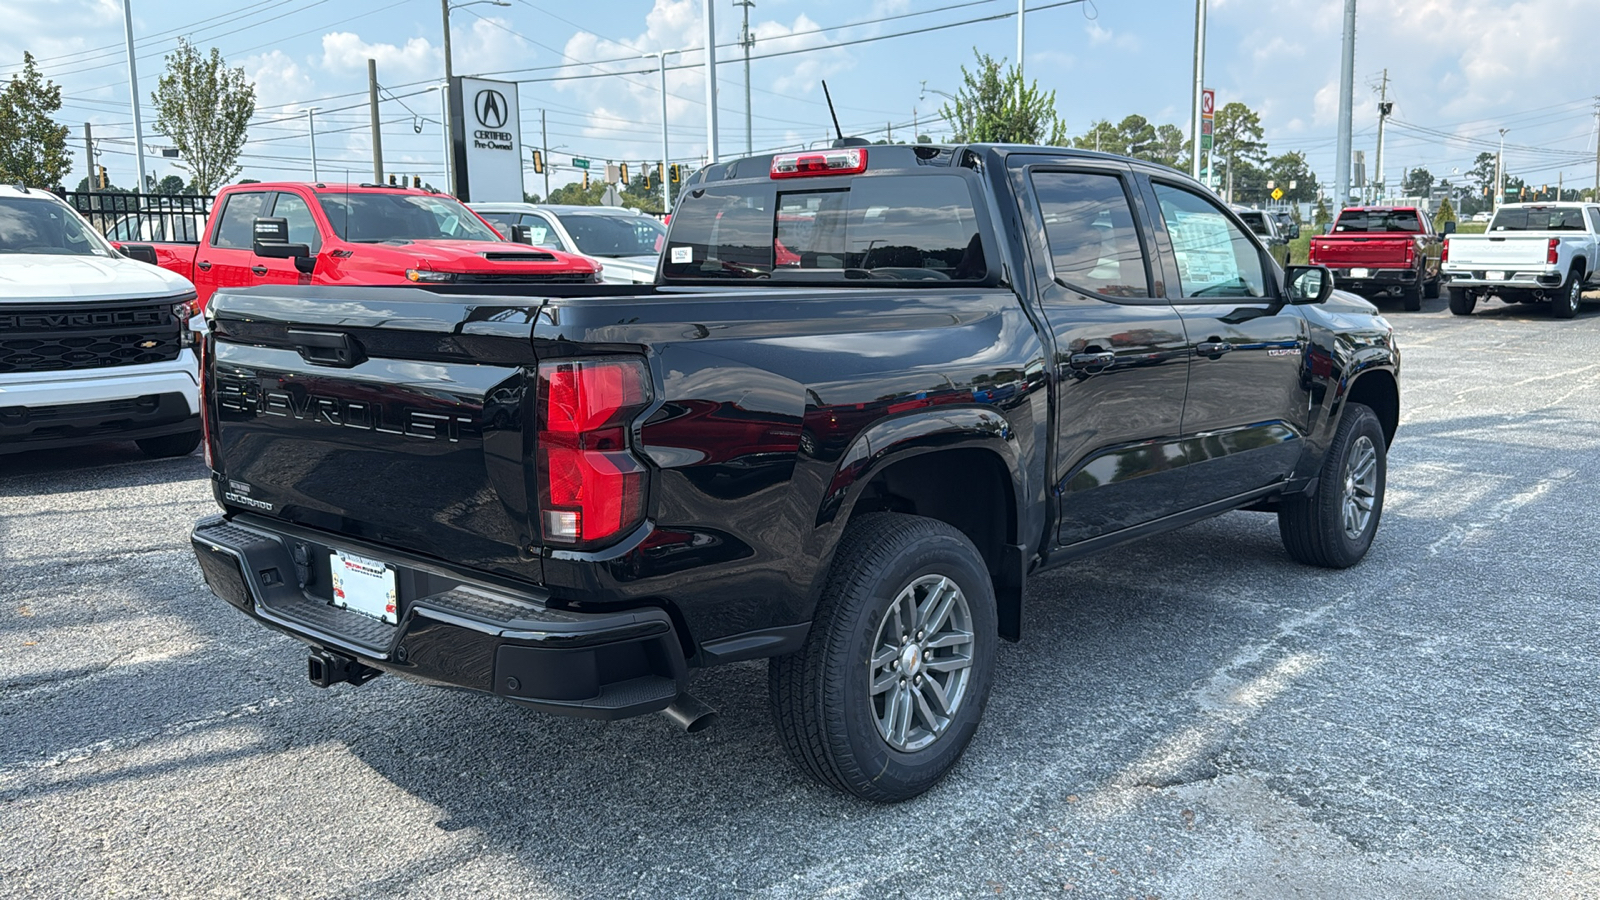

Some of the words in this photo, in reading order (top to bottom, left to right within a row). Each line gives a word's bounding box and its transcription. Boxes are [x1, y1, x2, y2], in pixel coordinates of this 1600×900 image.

[473, 130, 513, 141] CERTIFIED
[474, 140, 513, 151] Pre-Owned
[221, 382, 472, 442] CHEVROLET
[225, 492, 273, 511] COLORADO
